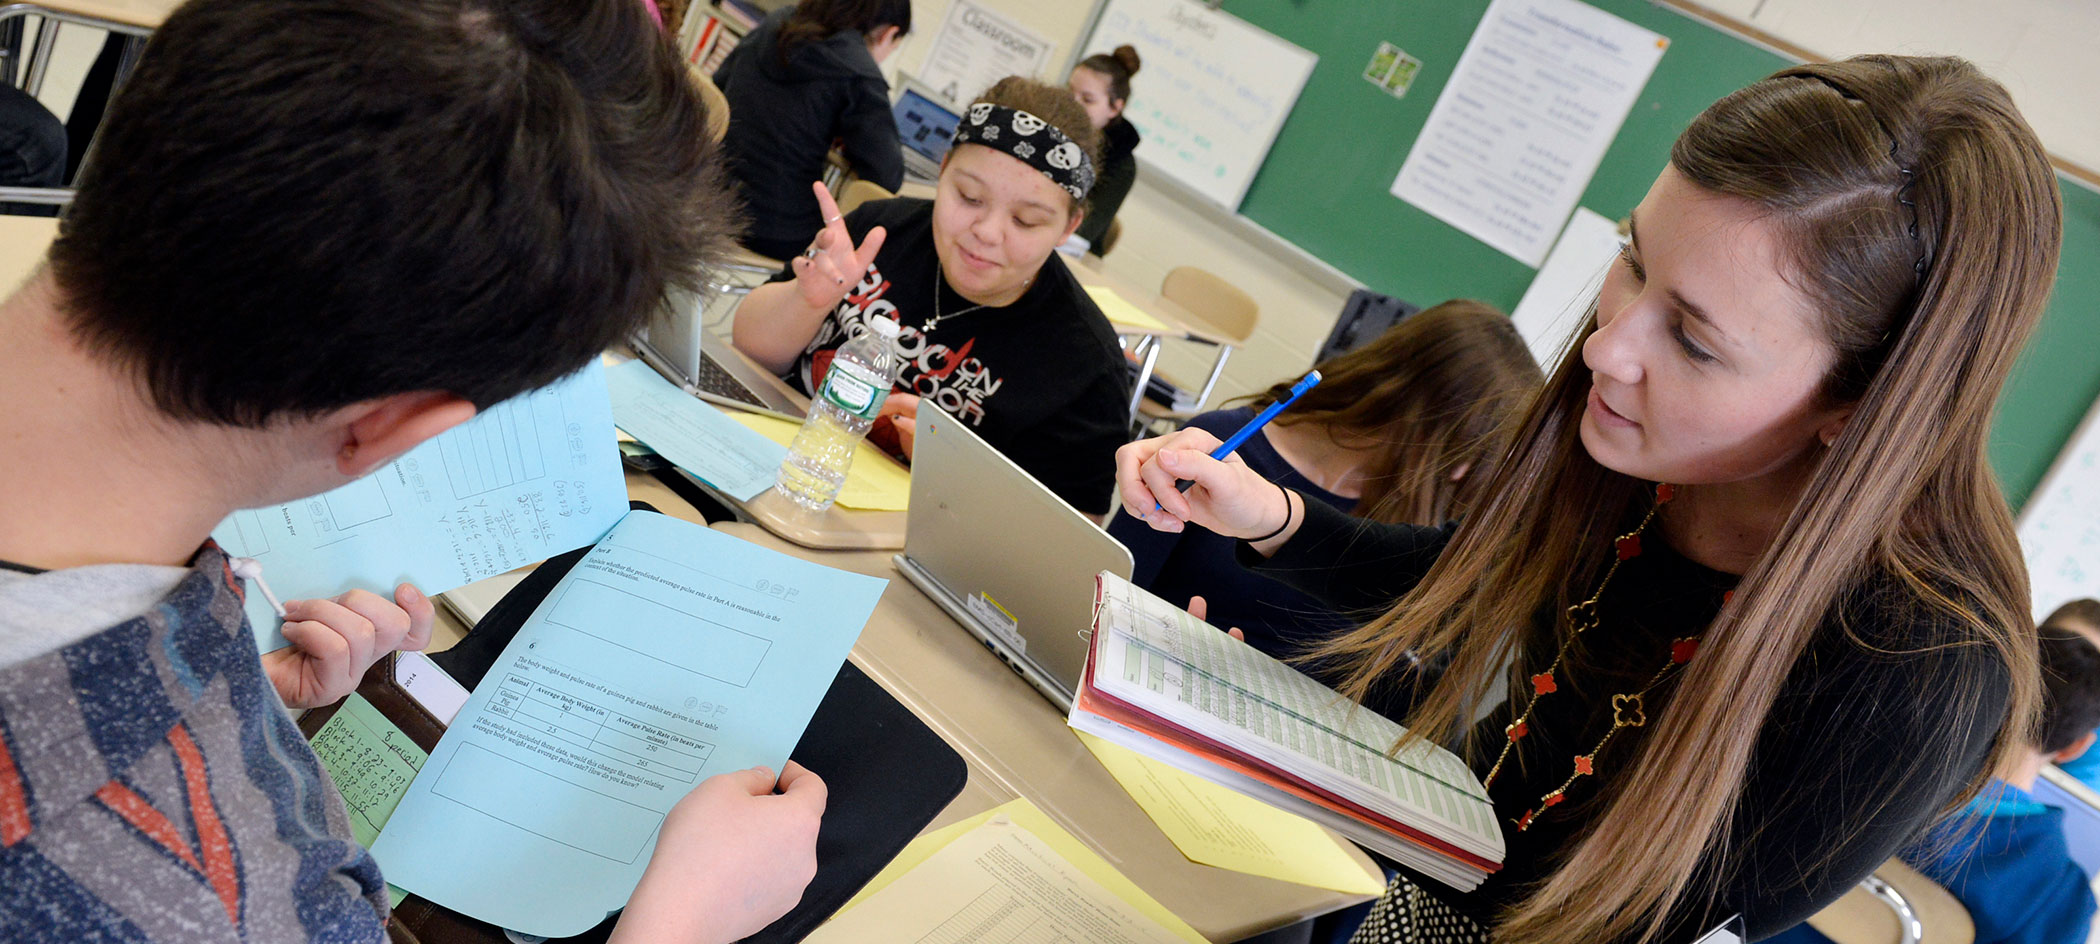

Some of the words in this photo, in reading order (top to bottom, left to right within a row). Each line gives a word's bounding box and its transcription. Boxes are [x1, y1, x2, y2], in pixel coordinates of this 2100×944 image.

[962, 8, 1036, 60] Classroom
[963, 358, 1003, 397] ON
[607, 566, 616, 574] the
[616, 570, 639, 582] situation.
[605, 560, 626, 571] whether
[625, 565, 635, 573] the
[633, 568, 660, 582] predicted
[658, 578, 680, 589] average
[678, 584, 695, 595] pulse
[695, 590, 706, 598] rate
[712, 595, 724, 604] Part
[735, 603, 765, 617] reasonable
[771, 614, 781, 622] the
[528, 641, 536, 650] 6
[404, 672, 416, 687] 2014
[508, 676, 529, 687] Animal
[499, 689, 519, 701] Guinea
[517, 655, 528, 664] The
[526, 658, 542, 669] body
[540, 664, 560, 676] weight
[559, 671, 570, 679] and
[569, 674, 585, 685] pulse
[584, 680, 596, 689] rate
[606, 687, 626, 700] guinea
[624, 695, 636, 704] pig
[635, 699, 647, 707] and
[646, 702, 664, 713] rabbit
[671, 711, 688, 722] given
[694, 718, 704, 726] the
[703, 721, 719, 731] table
[535, 686, 560, 700] Average
[559, 694, 576, 706] Body
[574, 700, 596, 713] Weight
[490, 704, 509, 715] Rabbit
[500, 697, 511, 706] Pig
[561, 703, 572, 711] kg)
[330, 716, 357, 739] Block
[546, 725, 557, 734] 2.5
[616, 716, 640, 730] Average
[640, 724, 657, 735] Pulse
[656, 729, 670, 739] Rate
[678, 737, 694, 747] beats
[693, 743, 705, 751] per
[316, 733, 339, 756] Block
[645, 734, 668, 746] minute)
[645, 743, 658, 752] 250
[387, 742, 419, 765] period
[472, 722, 493, 735] average
[492, 729, 507, 741] body
[506, 736, 526, 748] weight
[525, 743, 537, 752] and
[536, 747, 559, 761] average
[557, 755, 574, 767] pulse
[573, 761, 588, 772] rate?
[587, 766, 601, 776] How
[607, 775, 620, 784] you
[620, 777, 639, 789] know?
[482, 718, 492, 726] the
[490, 721, 506, 732] study
[505, 727, 517, 736] had
[515, 731, 541, 745] included
[540, 740, 555, 751] these
[554, 746, 569, 757] data,
[568, 751, 587, 763] would
[586, 758, 598, 767] this
[596, 762, 617, 775] change
[616, 769, 626, 777] the
[625, 772, 644, 783] model
[642, 778, 665, 791] relating
[636, 758, 648, 767] 265
